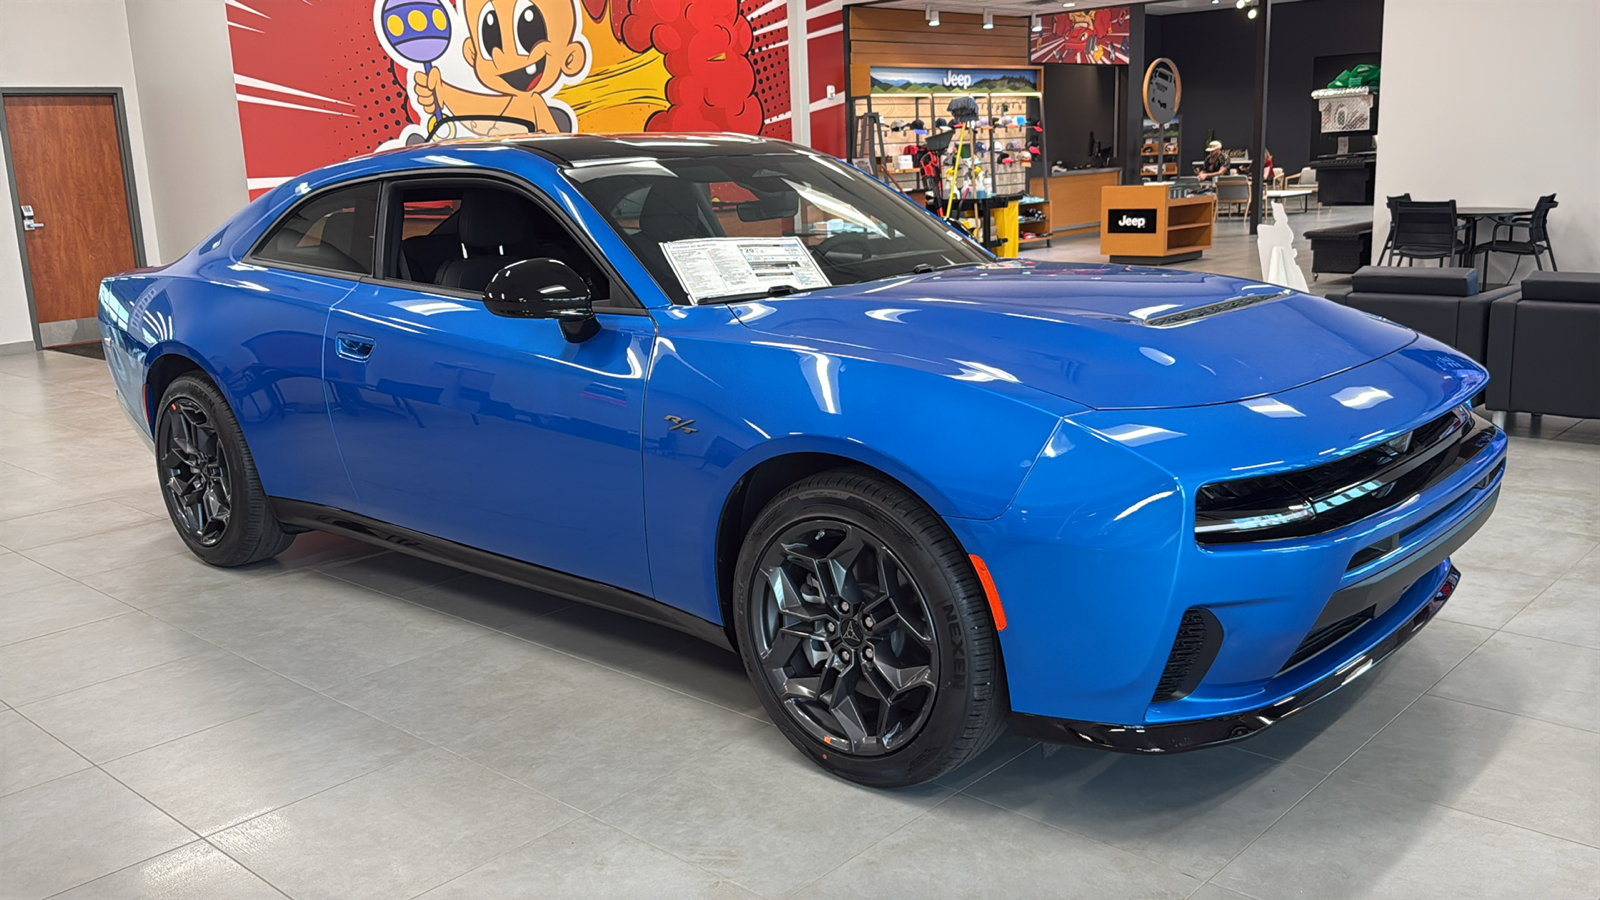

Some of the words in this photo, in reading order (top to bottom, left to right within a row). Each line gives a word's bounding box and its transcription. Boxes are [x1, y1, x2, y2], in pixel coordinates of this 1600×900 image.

[943, 69, 971, 90] Jeep
[1118, 214, 1146, 229] Jeep
[664, 414, 699, 434] R/T
[942, 604, 966, 690] NEXEN
